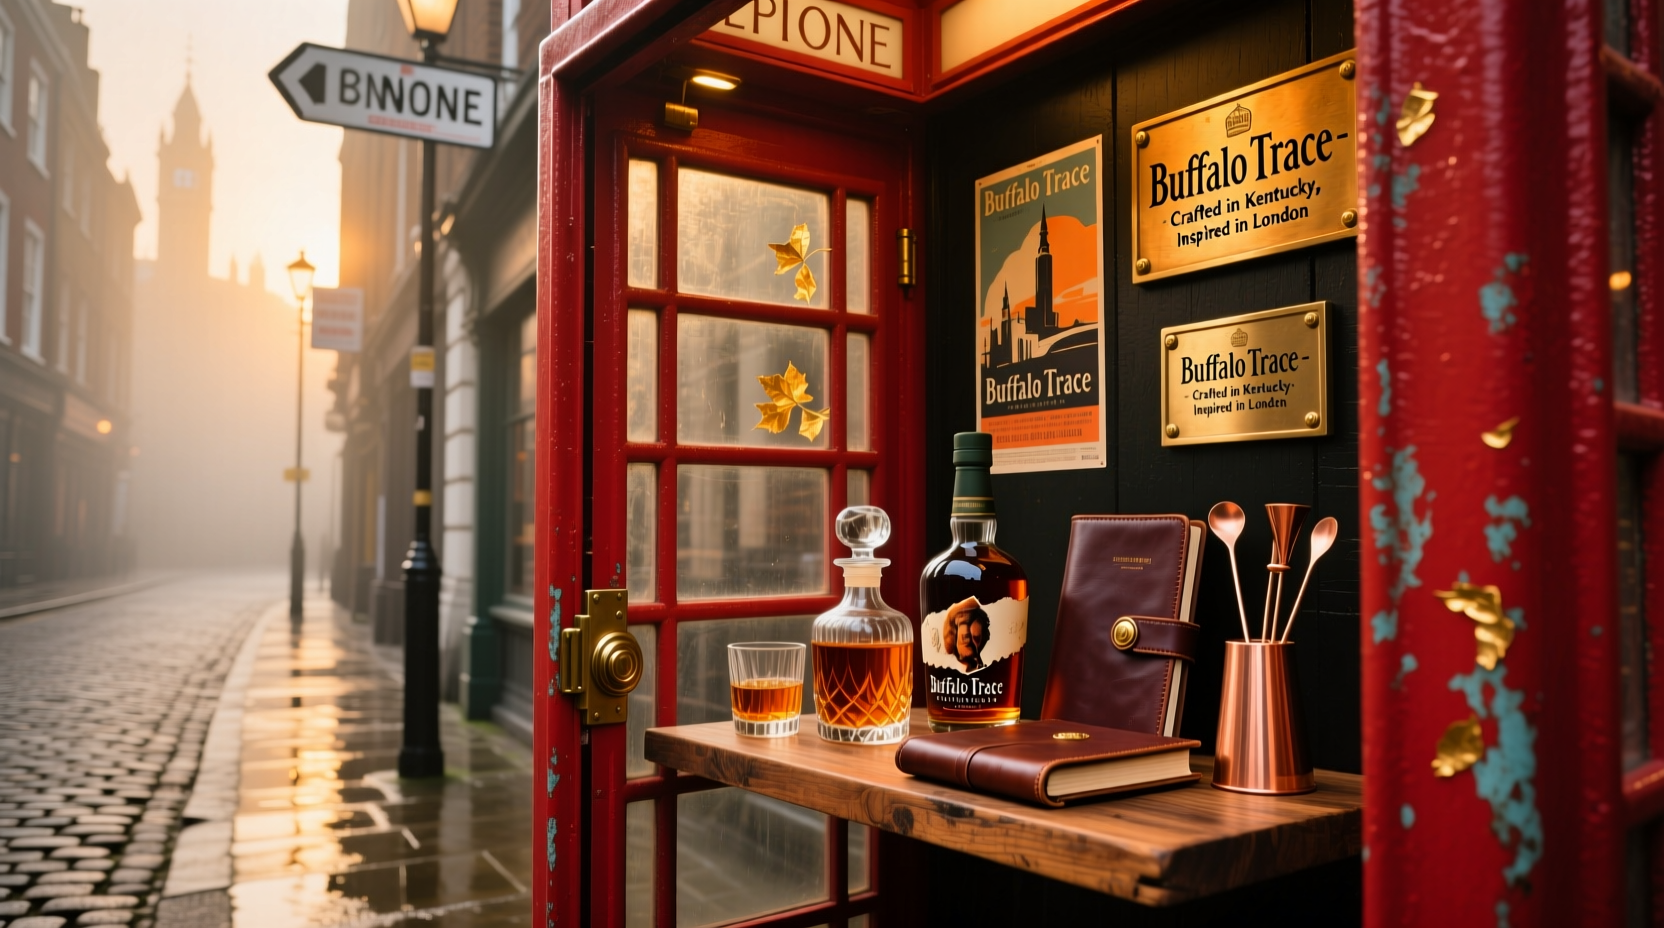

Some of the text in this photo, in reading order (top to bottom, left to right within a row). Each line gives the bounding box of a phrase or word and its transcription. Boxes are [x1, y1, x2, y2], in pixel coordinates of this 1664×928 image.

[984, 177, 1040, 217] Buffalo
[1042, 164, 1090, 196] Trace
[1149, 146, 1248, 209] Buffalo
[1170, 200, 1222, 227] Crafted
[1226, 198, 1240, 214] in
[1177, 205, 1309, 248] Inspired in London
[1180, 351, 1246, 385] Buffalo
[985, 368, 1092, 406] Buffalo Trace
[1230, 385, 1240, 397] in
[1235, 400, 1245, 411] in
[970, 677, 1003, 696] Trace
